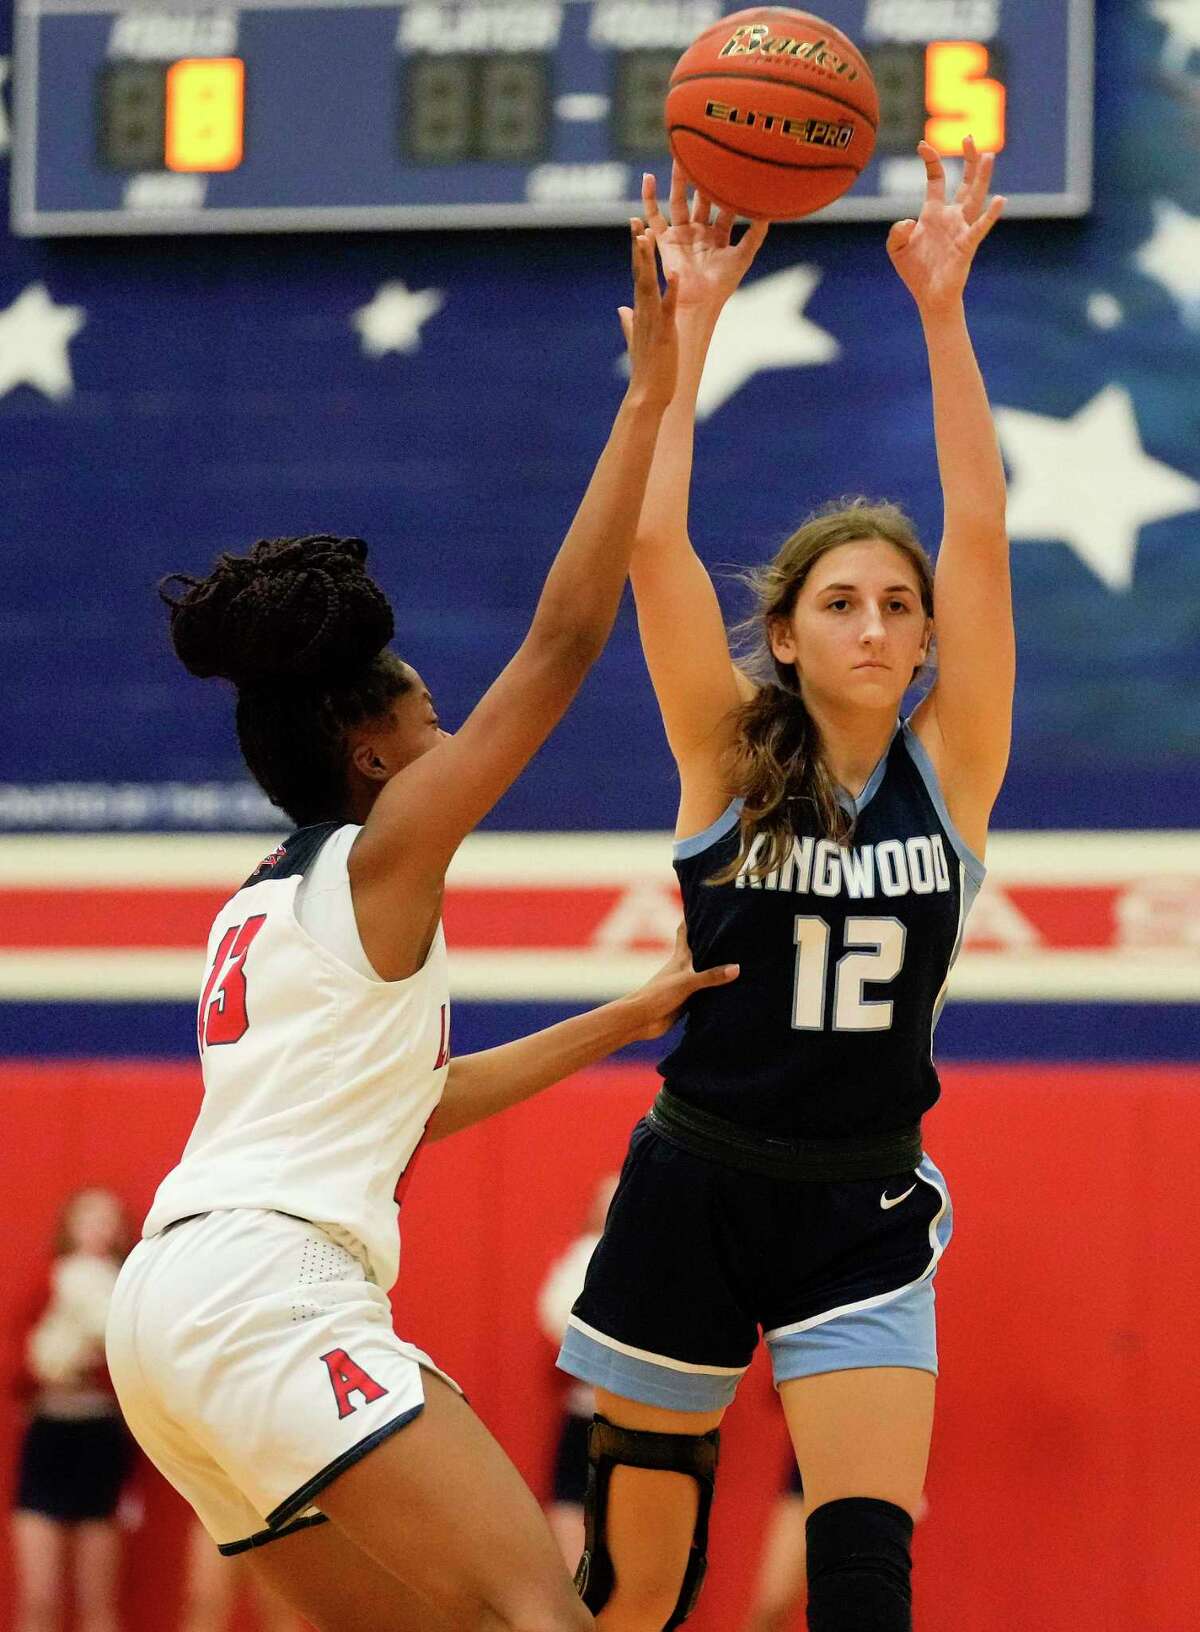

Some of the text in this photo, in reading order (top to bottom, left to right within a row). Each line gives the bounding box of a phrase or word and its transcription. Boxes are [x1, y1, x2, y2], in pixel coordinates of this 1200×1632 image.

[718, 24, 857, 81] Baden
[925, 41, 1005, 156] 5
[165, 57, 245, 172] 8
[704, 98, 854, 150] ELITE PRO
[199, 913, 268, 1055] 13
[791, 914, 907, 1031] 12
[319, 1347, 389, 1420] A
